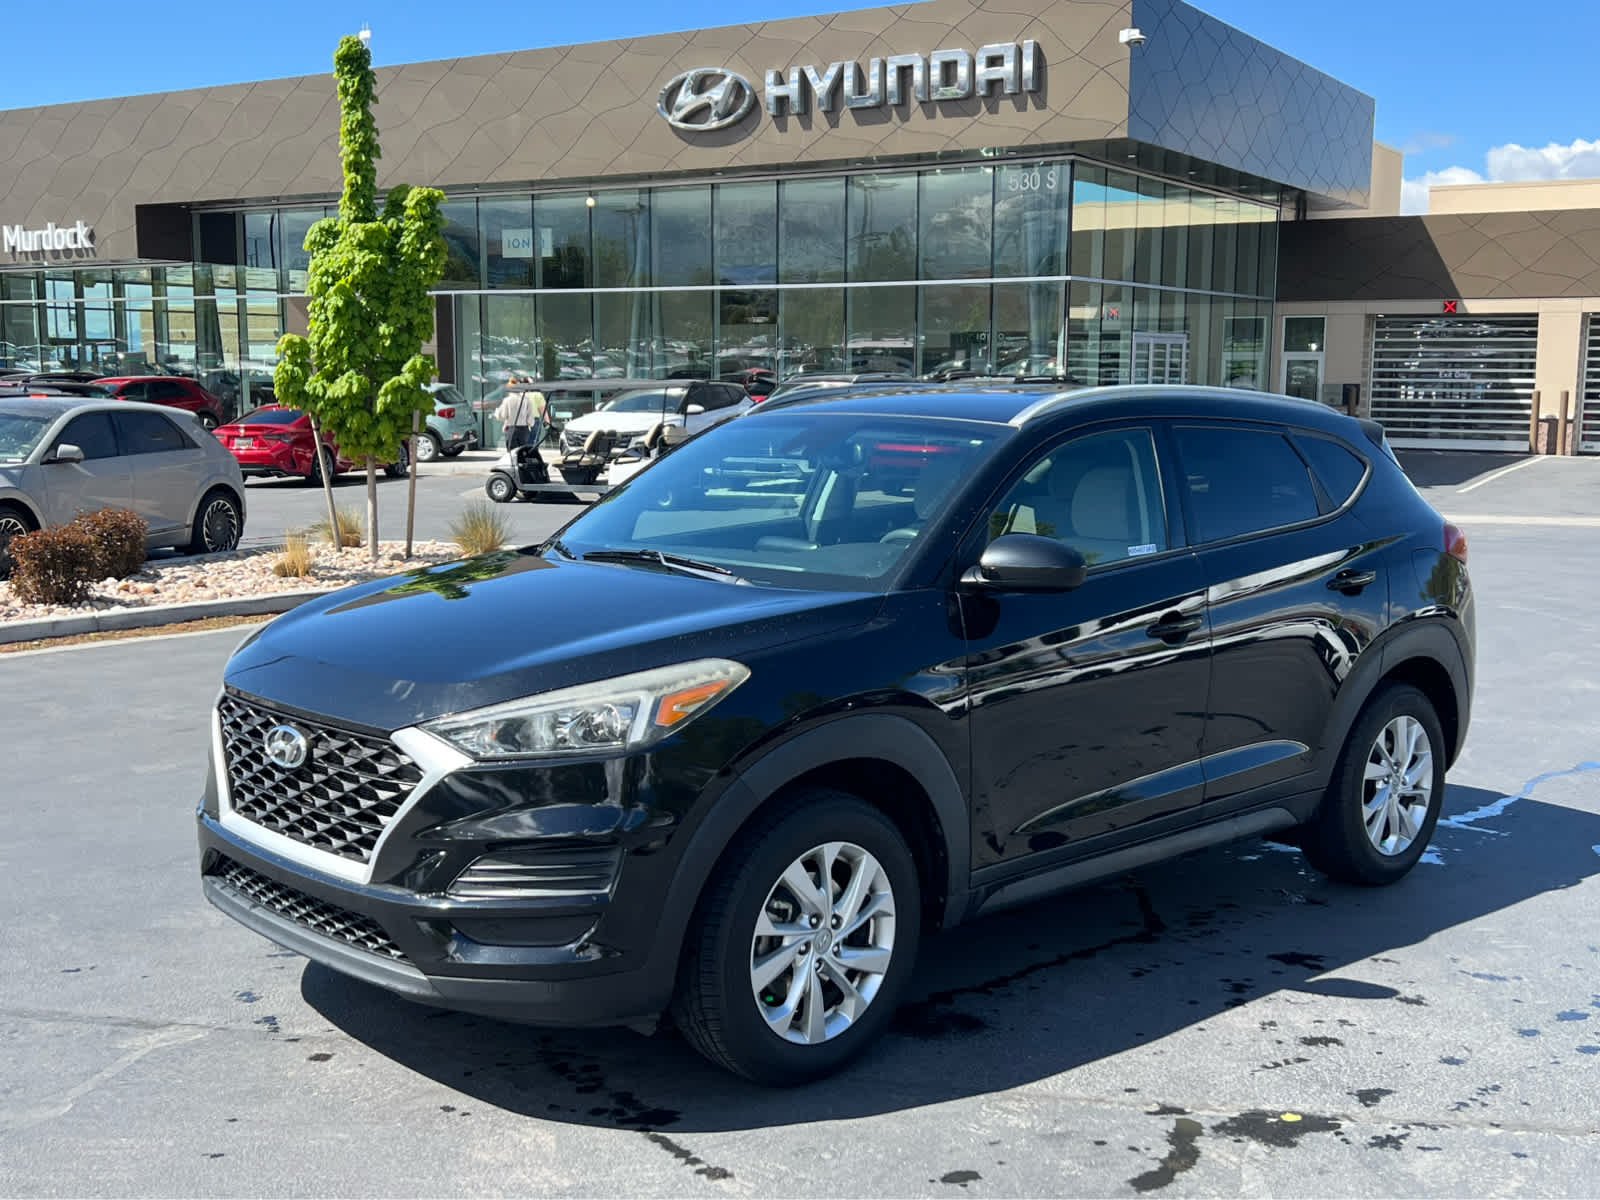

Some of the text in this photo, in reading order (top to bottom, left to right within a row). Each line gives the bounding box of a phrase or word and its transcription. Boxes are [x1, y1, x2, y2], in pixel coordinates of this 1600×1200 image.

[764, 39, 1041, 117] HYUNDAI
[1008, 169, 1057, 192] 530 S
[2, 220, 96, 253] Murdock
